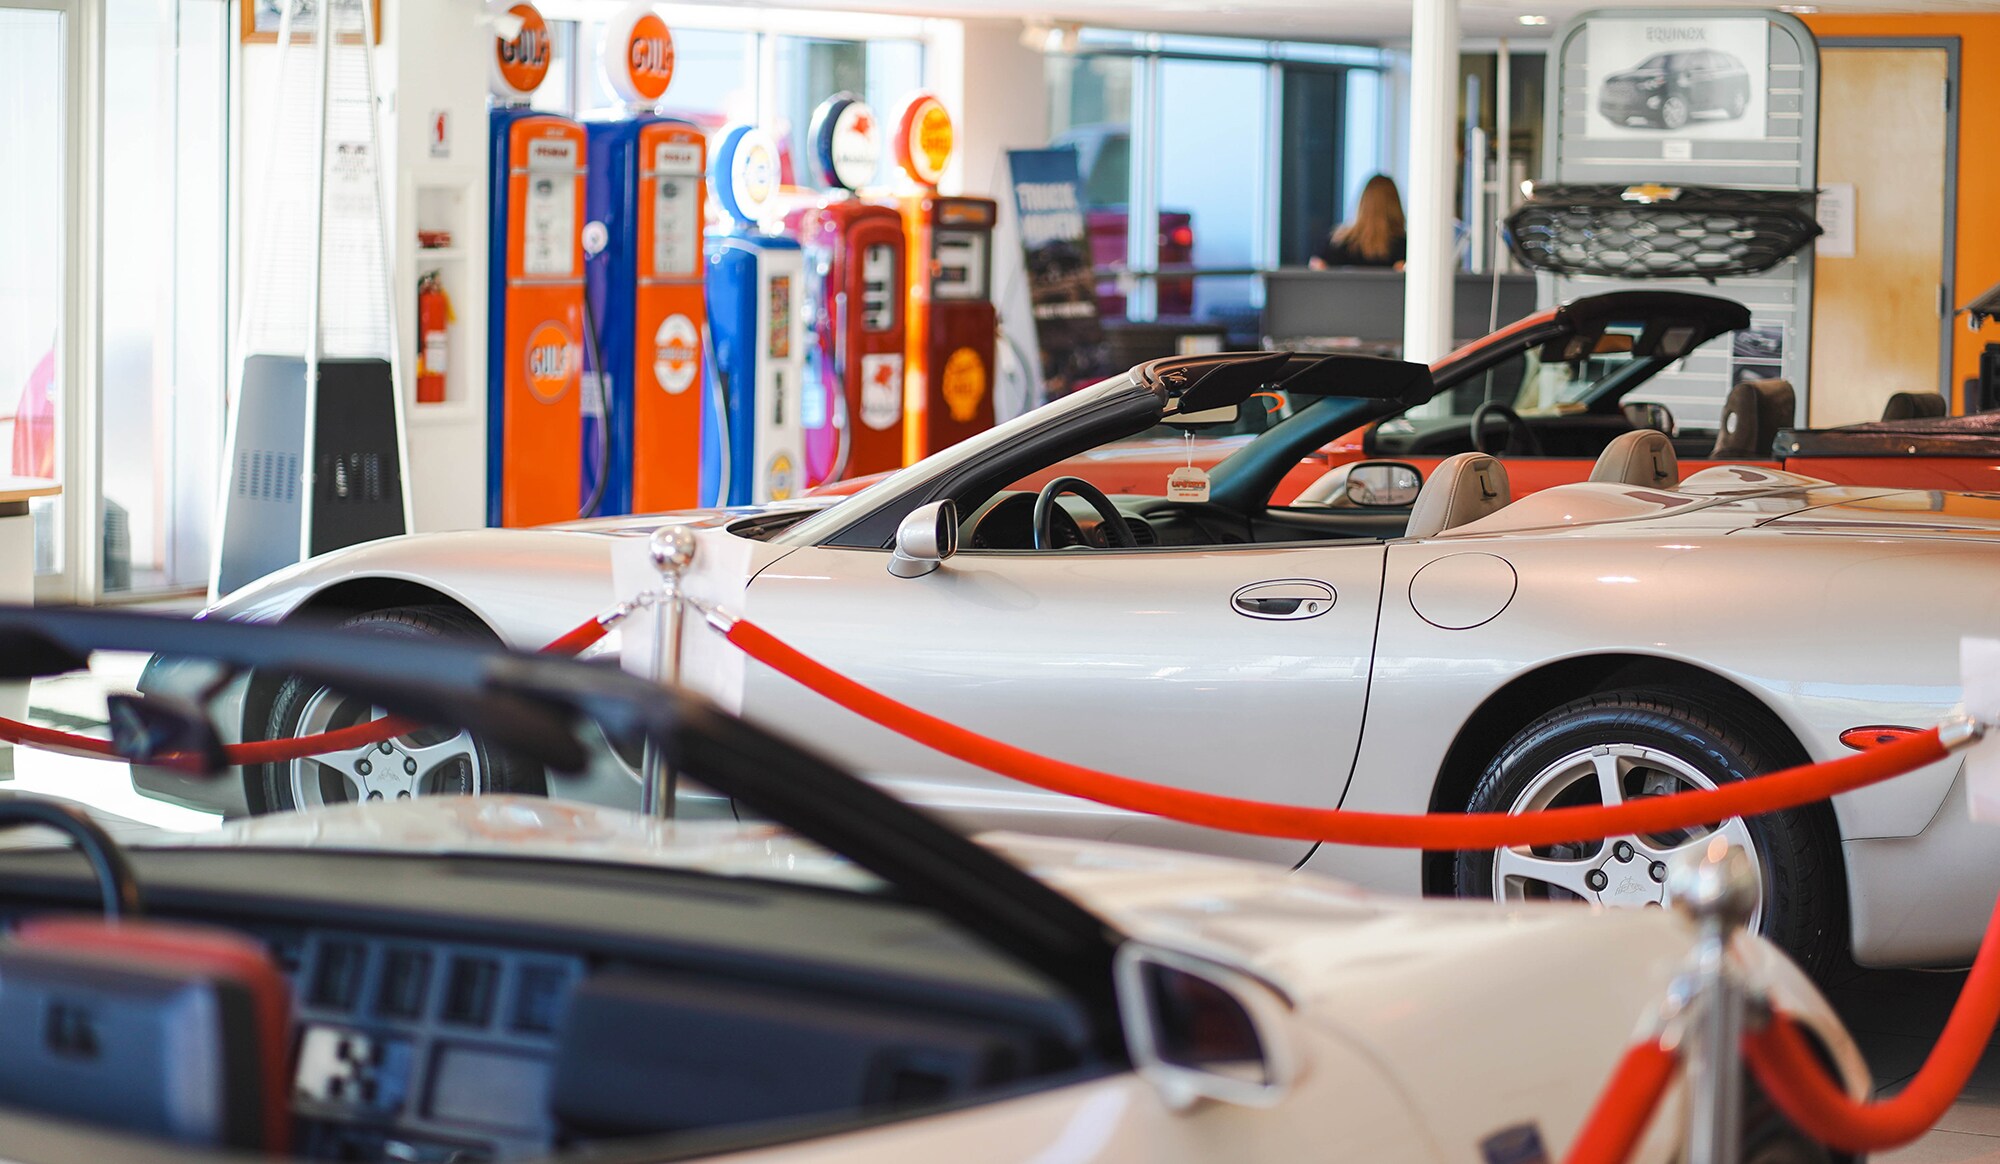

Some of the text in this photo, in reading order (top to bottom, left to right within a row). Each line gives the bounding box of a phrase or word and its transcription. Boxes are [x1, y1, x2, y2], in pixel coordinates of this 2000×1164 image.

[501, 28, 549, 64] GULF
[1645, 26, 1705, 43] EQUINOX
[631, 38, 673, 73] GULF
[529, 343, 573, 380] GULF
